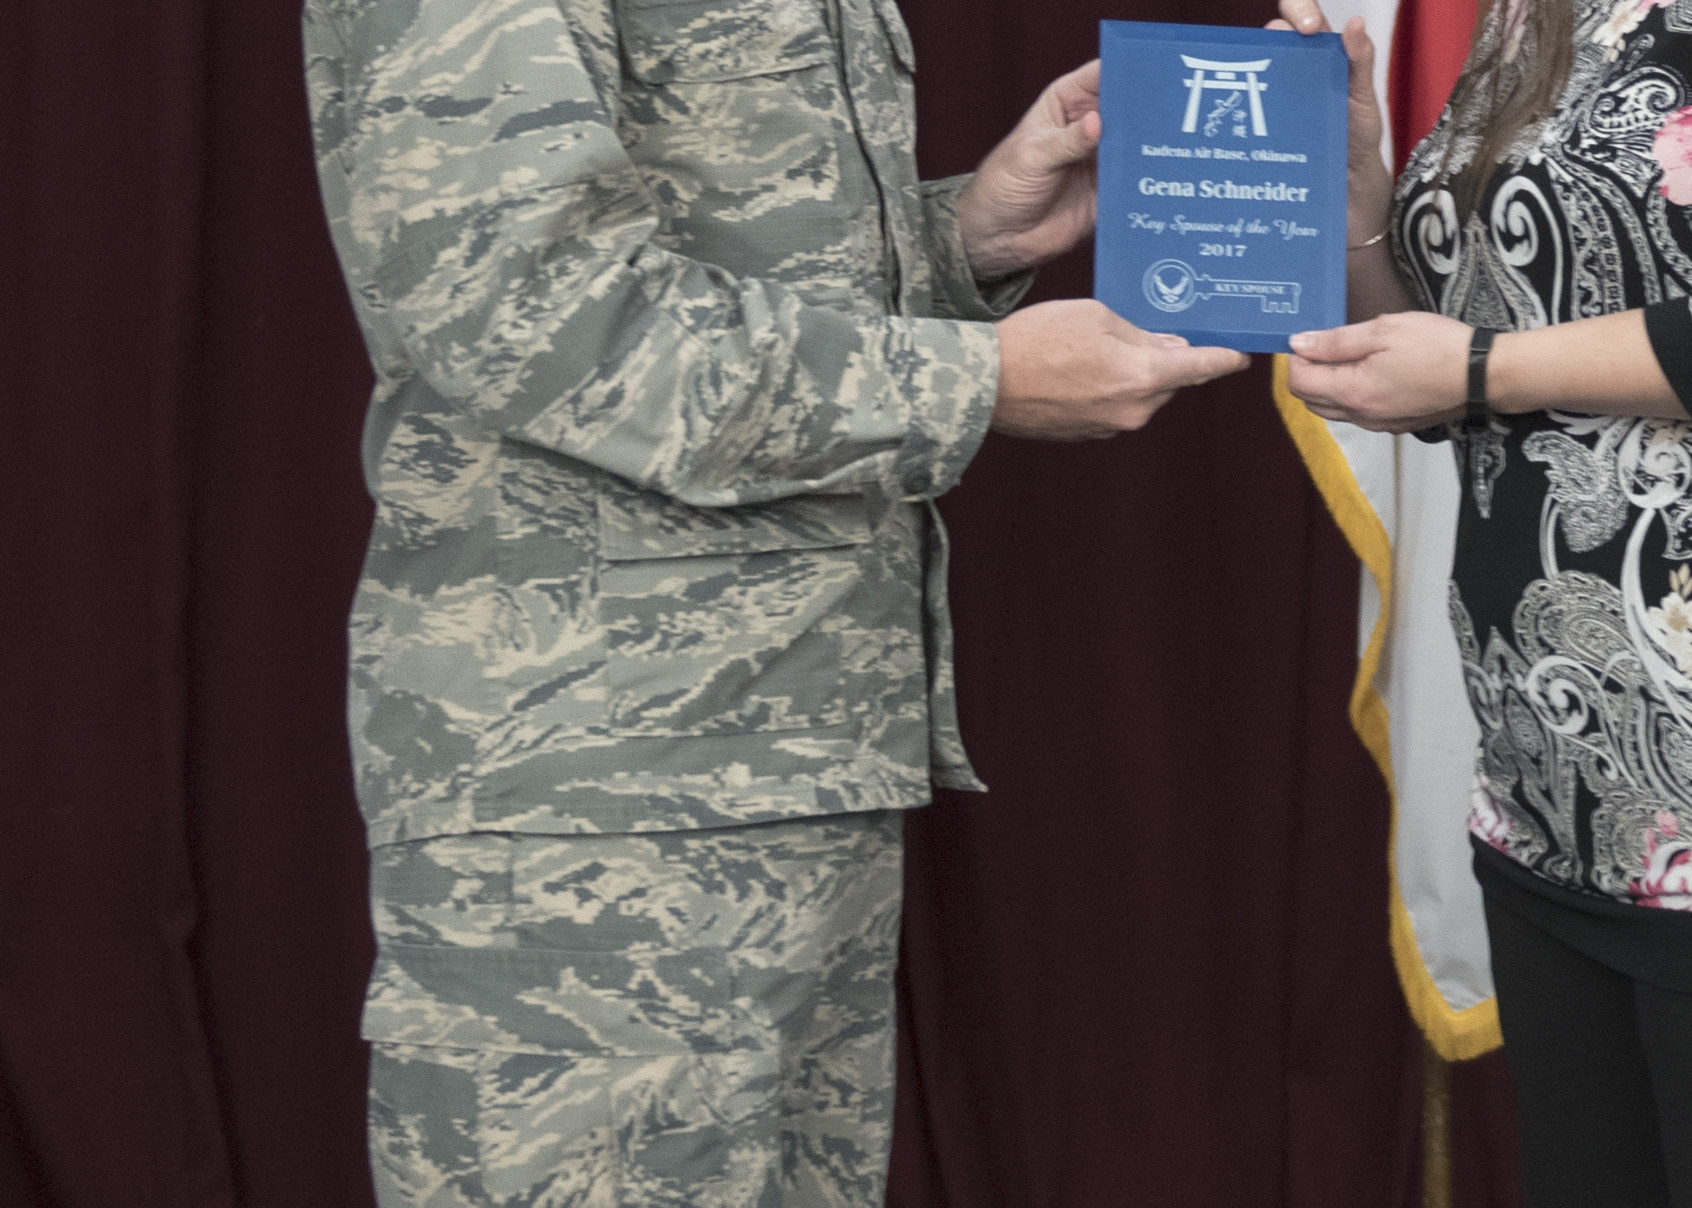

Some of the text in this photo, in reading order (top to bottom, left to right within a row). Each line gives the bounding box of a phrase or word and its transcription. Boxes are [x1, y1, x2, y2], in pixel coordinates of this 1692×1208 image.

[1141, 144, 1192, 158] Kadena
[1194, 146, 1212, 159] Air
[1251, 149, 1308, 163] Okinawa
[1138, 177, 1309, 202] Gena Schneider
[1127, 212, 1319, 240] Key Spouse of the Year
[1199, 243, 1247, 257] 2017
[1214, 283, 1285, 294] KEY SPOUSE
